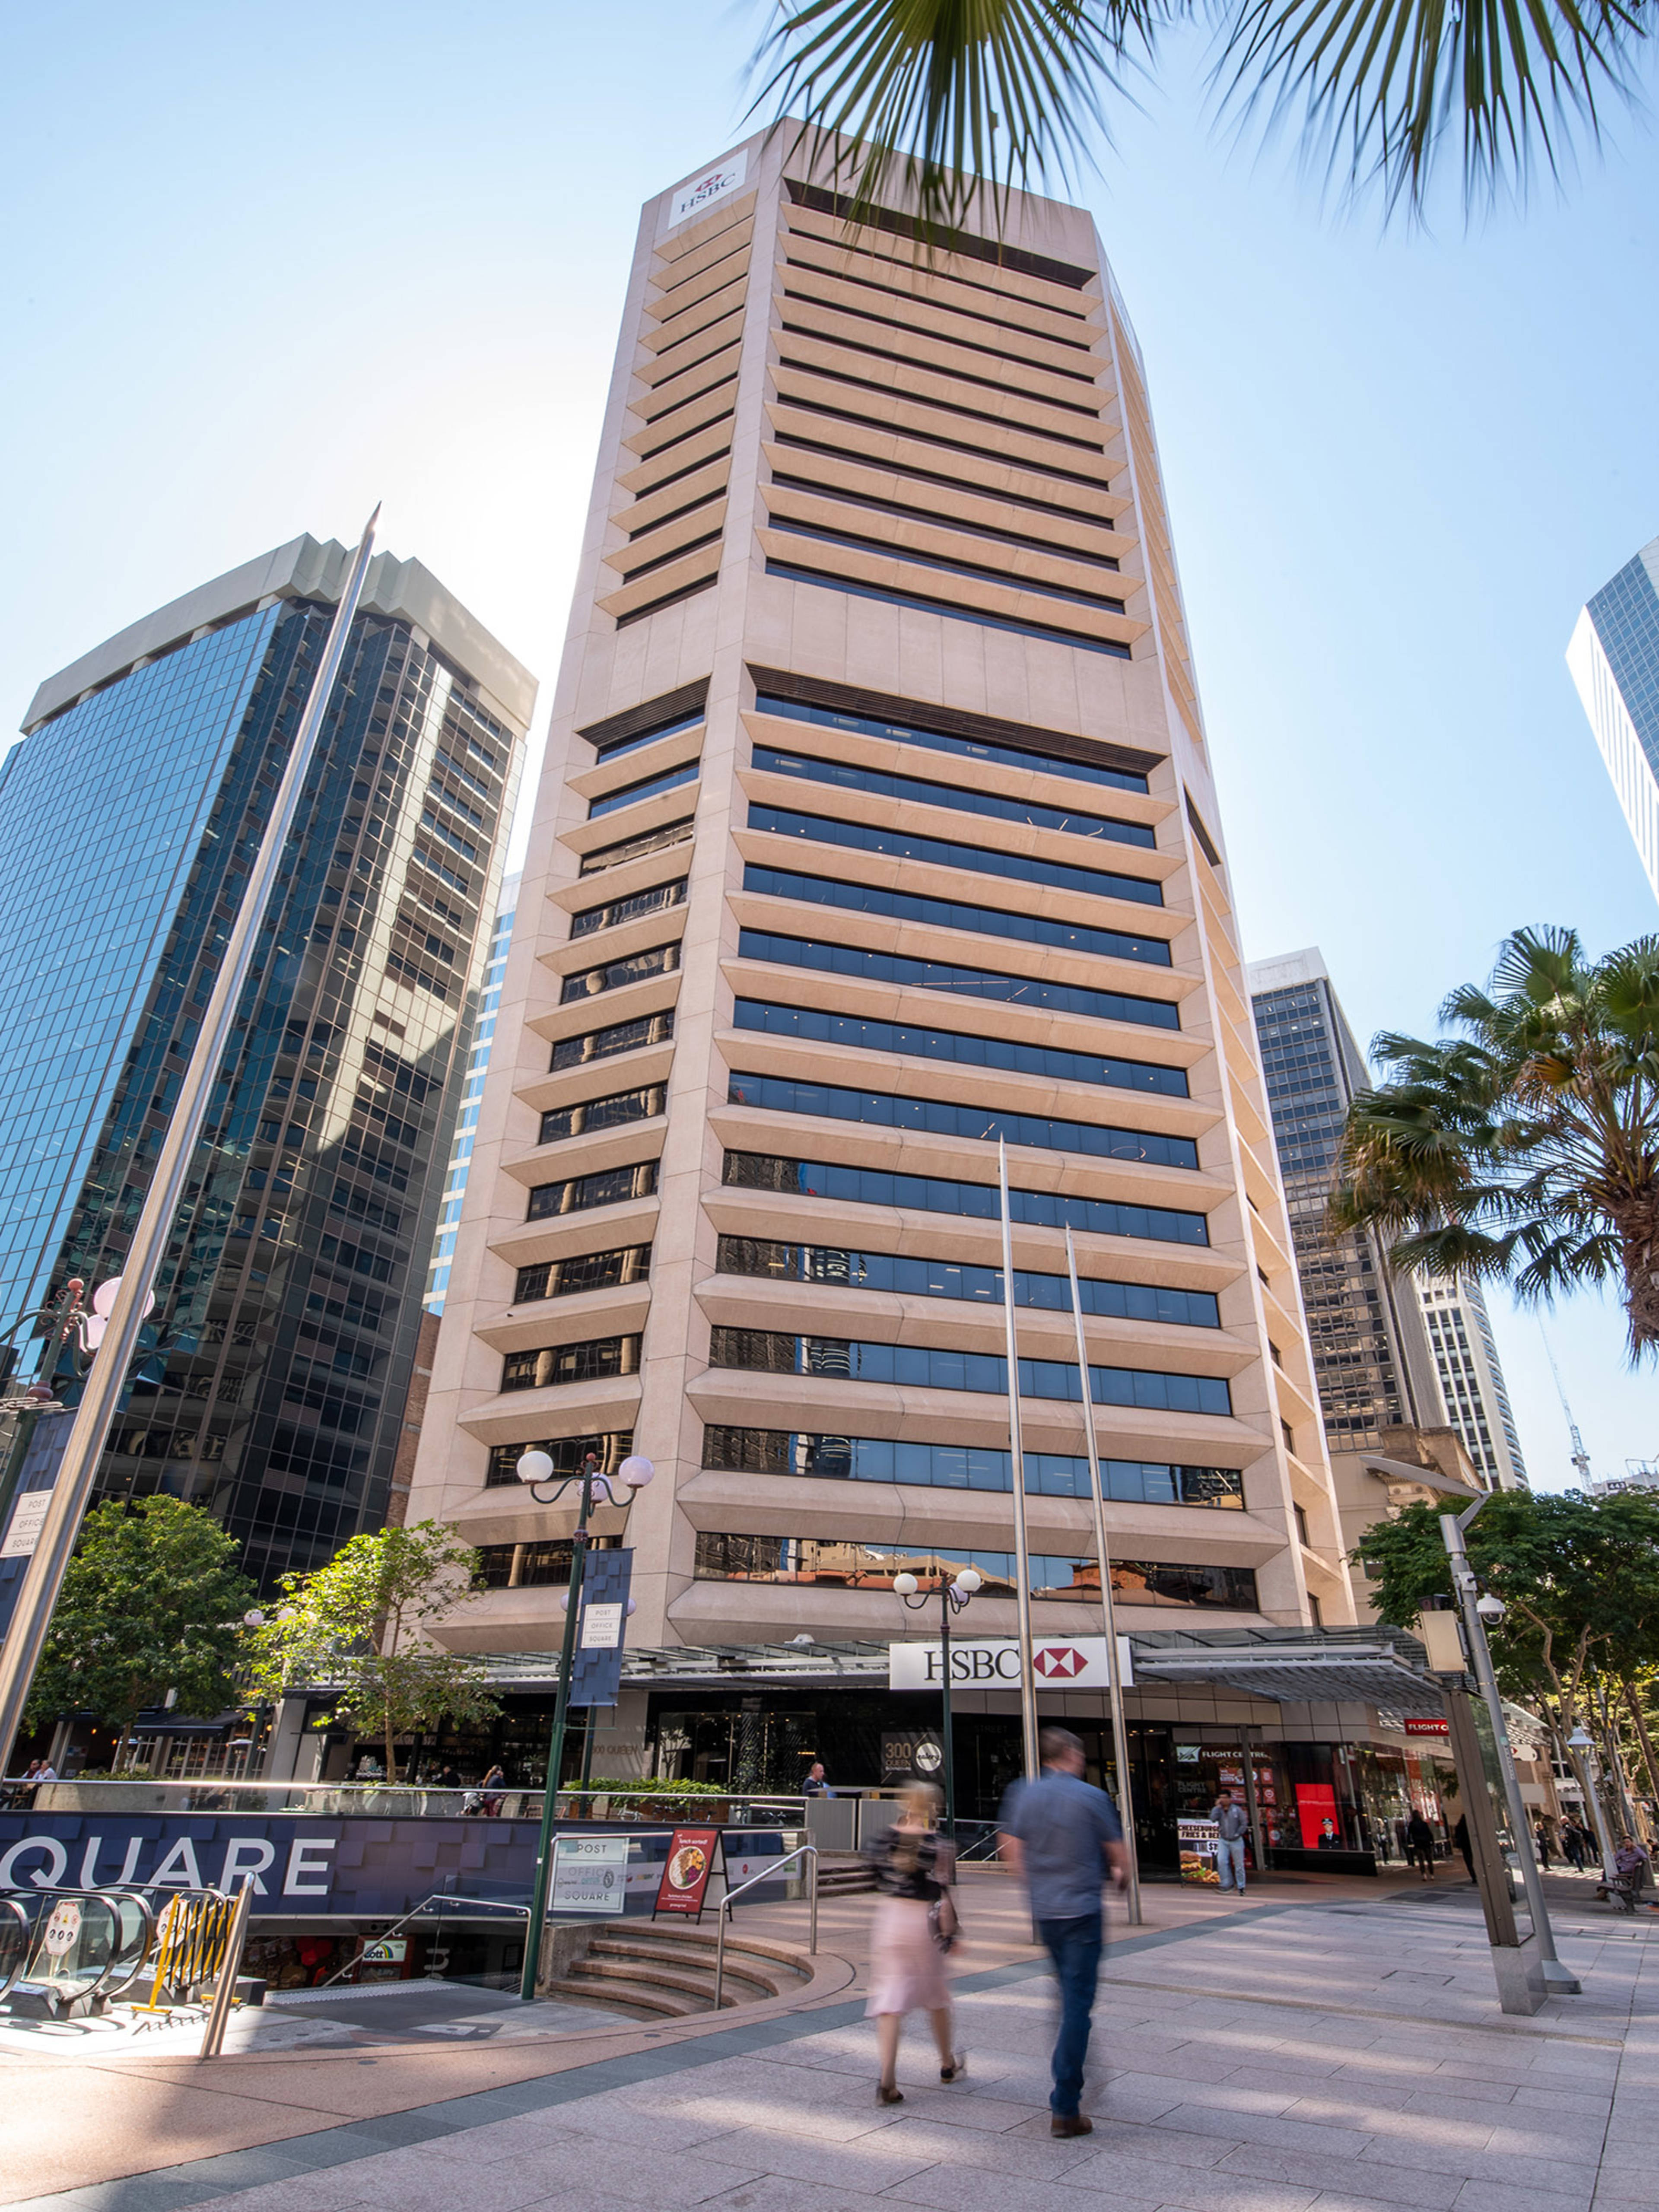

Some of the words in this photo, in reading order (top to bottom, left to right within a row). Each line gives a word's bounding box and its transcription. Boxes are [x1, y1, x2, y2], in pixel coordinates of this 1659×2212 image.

[680, 172, 736, 213] HSBC
[29, 1499, 46, 1508] POST
[924, 1648, 1021, 1680] HSBC
[886, 1742, 911, 1759] 300
[577, 1843, 607, 1853] POST
[564, 1890, 610, 1901] SQUARE
